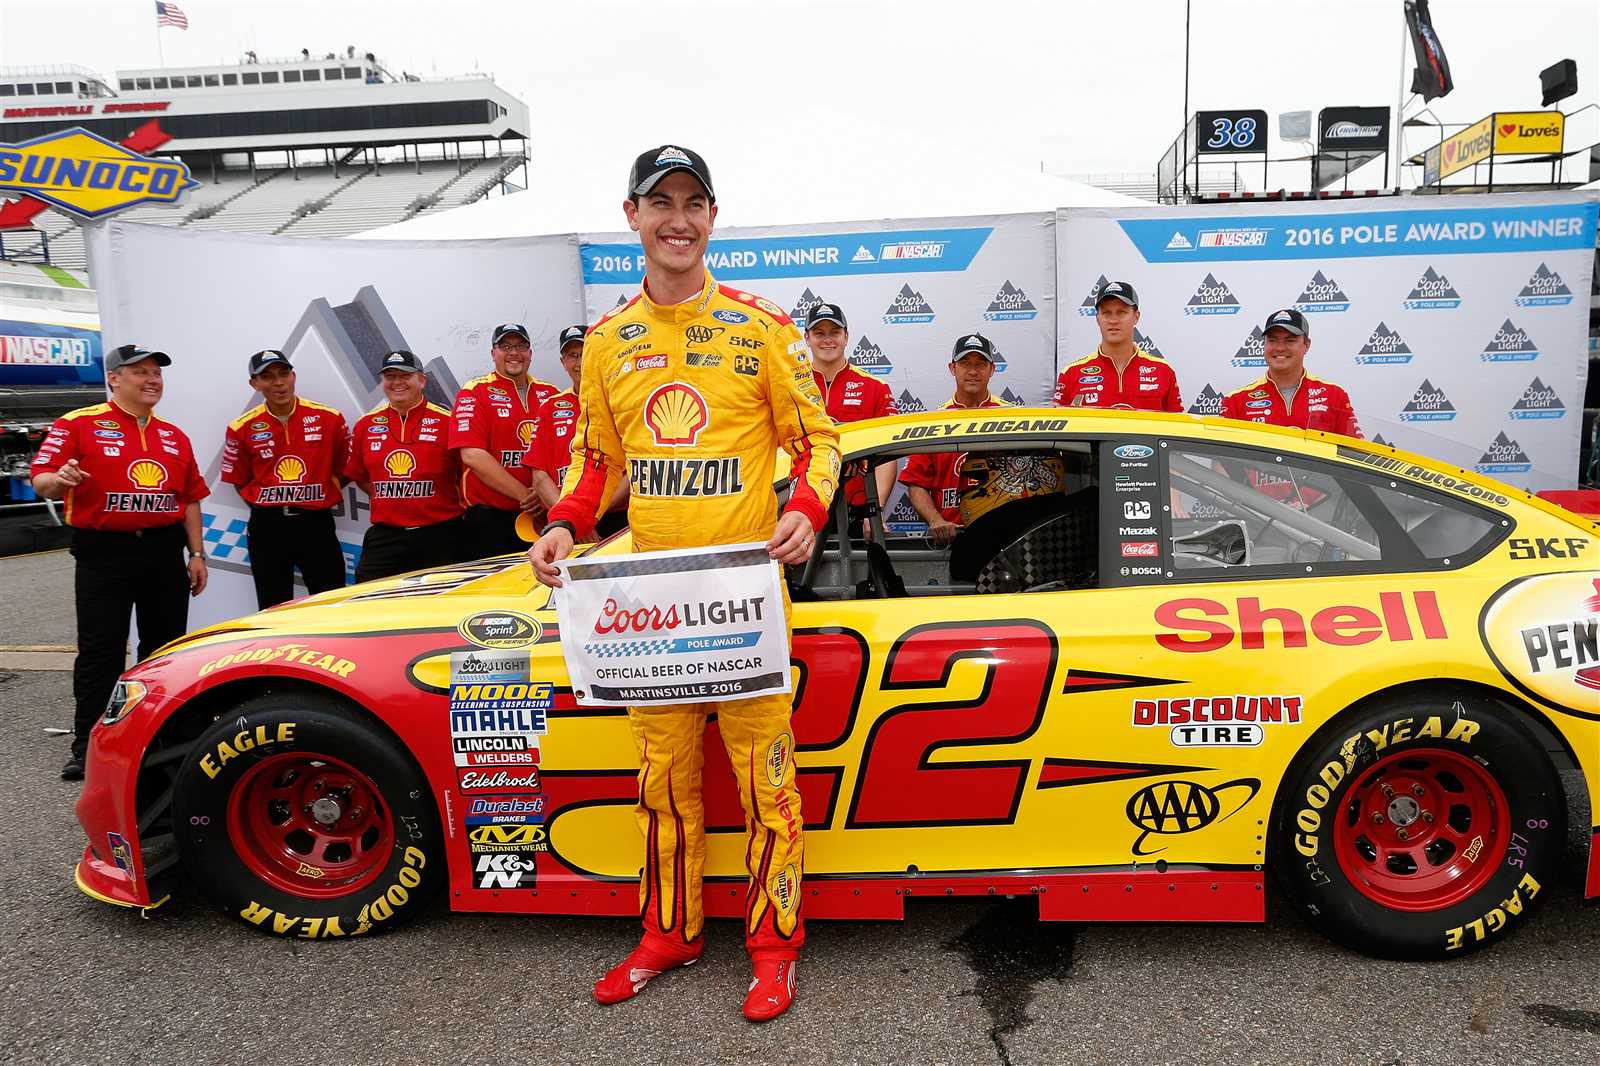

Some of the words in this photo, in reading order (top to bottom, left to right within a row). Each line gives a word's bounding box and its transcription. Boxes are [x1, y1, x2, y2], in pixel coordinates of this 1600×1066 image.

[1207, 117, 1256, 148] 38
[1518, 123, 1560, 137] Love's
[1457, 125, 1491, 164] Love's
[0, 152, 179, 195] SUNOCO
[1285, 229, 1334, 246] 2016
[1340, 225, 1398, 244] POLE
[1404, 222, 1486, 242] AWARD
[1492, 217, 1584, 239] WINNER
[1222, 232, 1264, 246] NASCAR
[704, 251, 758, 269] WARD
[763, 247, 839, 266] WINNER
[902, 245, 941, 258] NASCAR
[593, 256, 632, 272] 2016
[1304, 281, 1340, 294] Coors
[1416, 276, 1452, 290] Coors
[1528, 273, 1564, 288] Coors
[994, 289, 1028, 303] Coors
[1197, 283, 1231, 296] Coors
[1421, 289, 1445, 297] LIGHT
[893, 293, 926, 306] Coors
[1201, 295, 1226, 303] LIGHT
[1310, 293, 1335, 301] LIGHT
[898, 305, 921, 313] LIGHT
[999, 302, 1022, 310] LIGHT
[718, 311, 743, 323] Ford
[688, 327, 710, 343] AAA
[1368, 333, 1403, 346] Coors
[1494, 329, 1529, 343] Coors
[5, 336, 86, 364] NASCAR
[728, 336, 765, 350] SKF
[1498, 342, 1523, 350] LIGHT
[618, 343, 652, 359] GOODYEAR
[852, 345, 884, 358] Coors
[735, 357, 759, 372] PPG
[1413, 389, 1447, 403] Coors
[1523, 387, 1557, 401] Coors
[892, 423, 961, 441] JOEY
[966, 419, 1069, 434] LOGANO
[1488, 440, 1522, 454] Coors
[1492, 453, 1517, 461] LIGHT
[630, 457, 743, 497] PENNZOIL
[374, 481, 435, 498] PENNZOIL
[1405, 465, 1509, 507] AutoZone
[256, 485, 325, 504] PENNZOIL
[104, 493, 180, 512] PENNZOIL
[1125, 502, 1149, 516] PPG
[1120, 526, 1158, 536] Mazak
[1509, 538, 1589, 560] SKF
[1132, 567, 1161, 575] BOSCH
[594, 597, 682, 634] Coors
[684, 597, 765, 626] LIGHT
[1154, 590, 1449, 653] Shell
[485, 625, 514, 636] Sprint
[687, 639, 709, 649] POLE
[712, 637, 744, 648] AWARD
[463, 658, 495, 672] Coors
[495, 661, 525, 671] LIGHT
[596, 664, 649, 680] OFFICIAL
[652, 662, 683, 677] BEER
[686, 660, 704, 675] OF
[707, 657, 763, 673] NASCAR
[452, 684, 551, 701] MOOG
[619, 685, 707, 699] MARTINSVILLE
[711, 682, 742, 694] 2016
[501, 700, 550, 708] SUSPENSION
[1133, 696, 1302, 726] DISCOUNT
[452, 710, 546, 732] MAHLE
[1180, 727, 1253, 743] TIRE
[199, 722, 297, 780] EAGLE
[457, 738, 524, 752] LINCOLN
[474, 753, 532, 763] WELDERS
[773, 740, 783, 777] PENNZOIL
[460, 771, 538, 789] Edelbrock
[472, 799, 543, 813] Duralast
[1136, 782, 1212, 833] AAA
[472, 843, 519, 852] MECHANIX
[521, 843, 548, 852] WEAR
[778, 870, 789, 909] PENNZOIL
[1445, 872, 1542, 950] EAGLE
